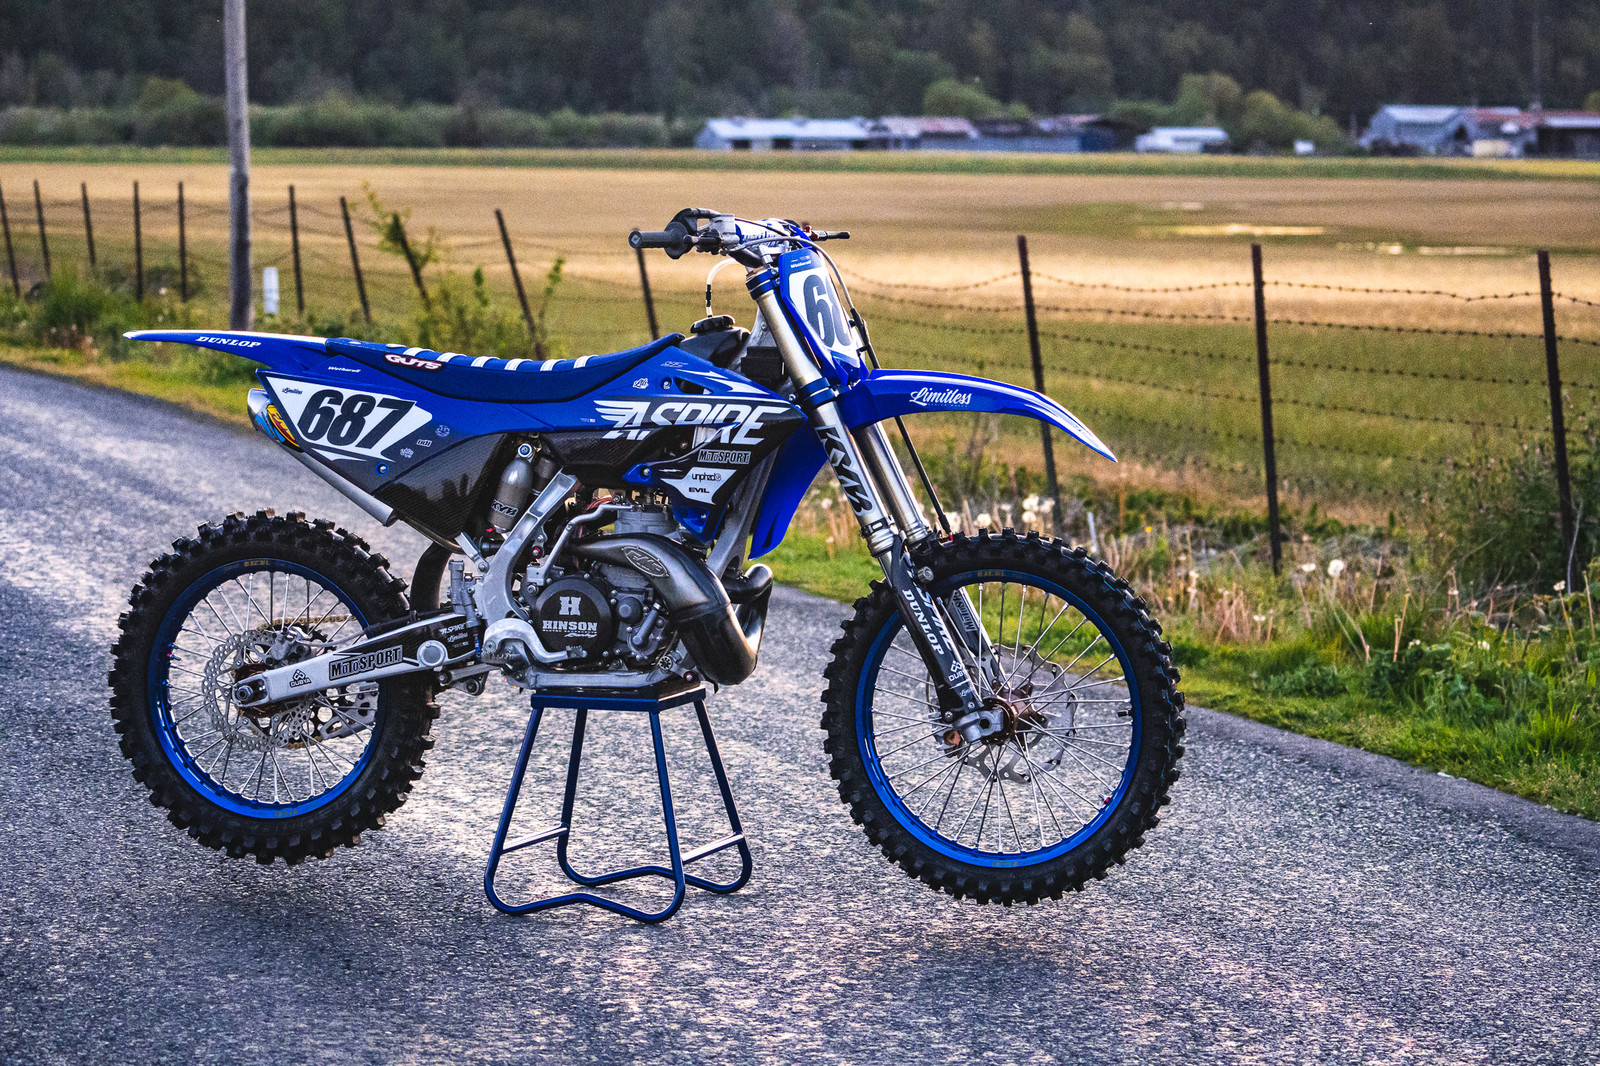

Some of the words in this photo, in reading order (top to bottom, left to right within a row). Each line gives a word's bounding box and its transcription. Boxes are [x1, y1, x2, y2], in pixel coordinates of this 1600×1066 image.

[195, 336, 262, 348] DUNLOP
[384, 353, 443, 370] GUTS
[908, 387, 973, 406] Limitless
[297, 389, 416, 450] 687
[688, 486, 710, 494] EVIL
[558, 596, 582, 616] H
[542, 619, 598, 632] HINSON
[901, 588, 945, 656] DUNLOP
